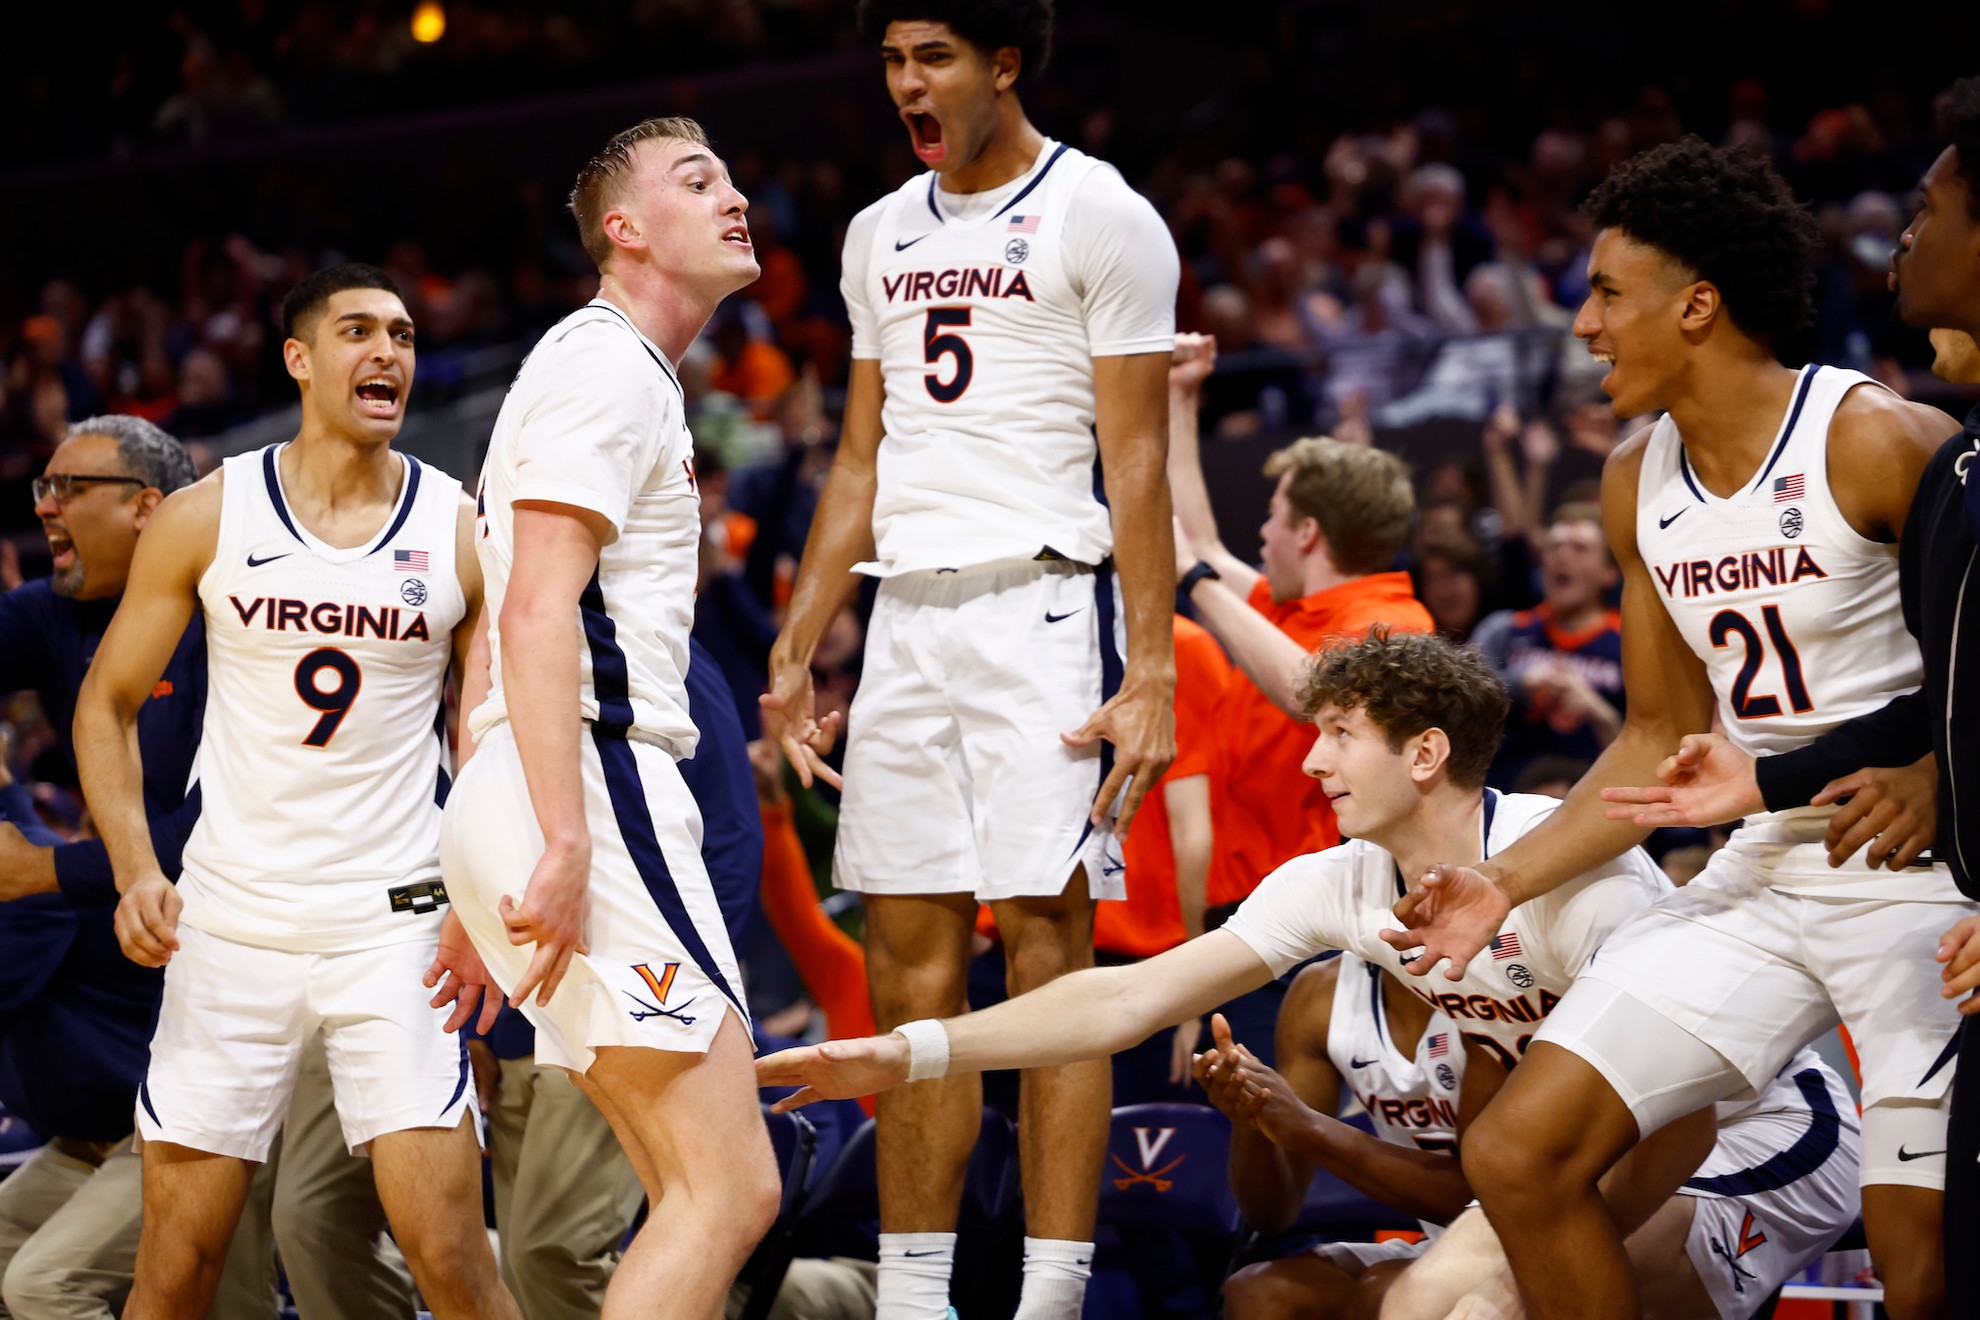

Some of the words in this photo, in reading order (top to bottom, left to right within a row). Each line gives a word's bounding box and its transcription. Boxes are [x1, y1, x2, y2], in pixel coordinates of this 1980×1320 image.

[883, 267, 1036, 304] VIRGINIA
[924, 306, 973, 404] 5
[1654, 545, 1829, 598] VIRGINIA
[228, 594, 430, 642] VIRGINIA
[294, 646, 362, 748] 9
[1709, 604, 1815, 720] 21
